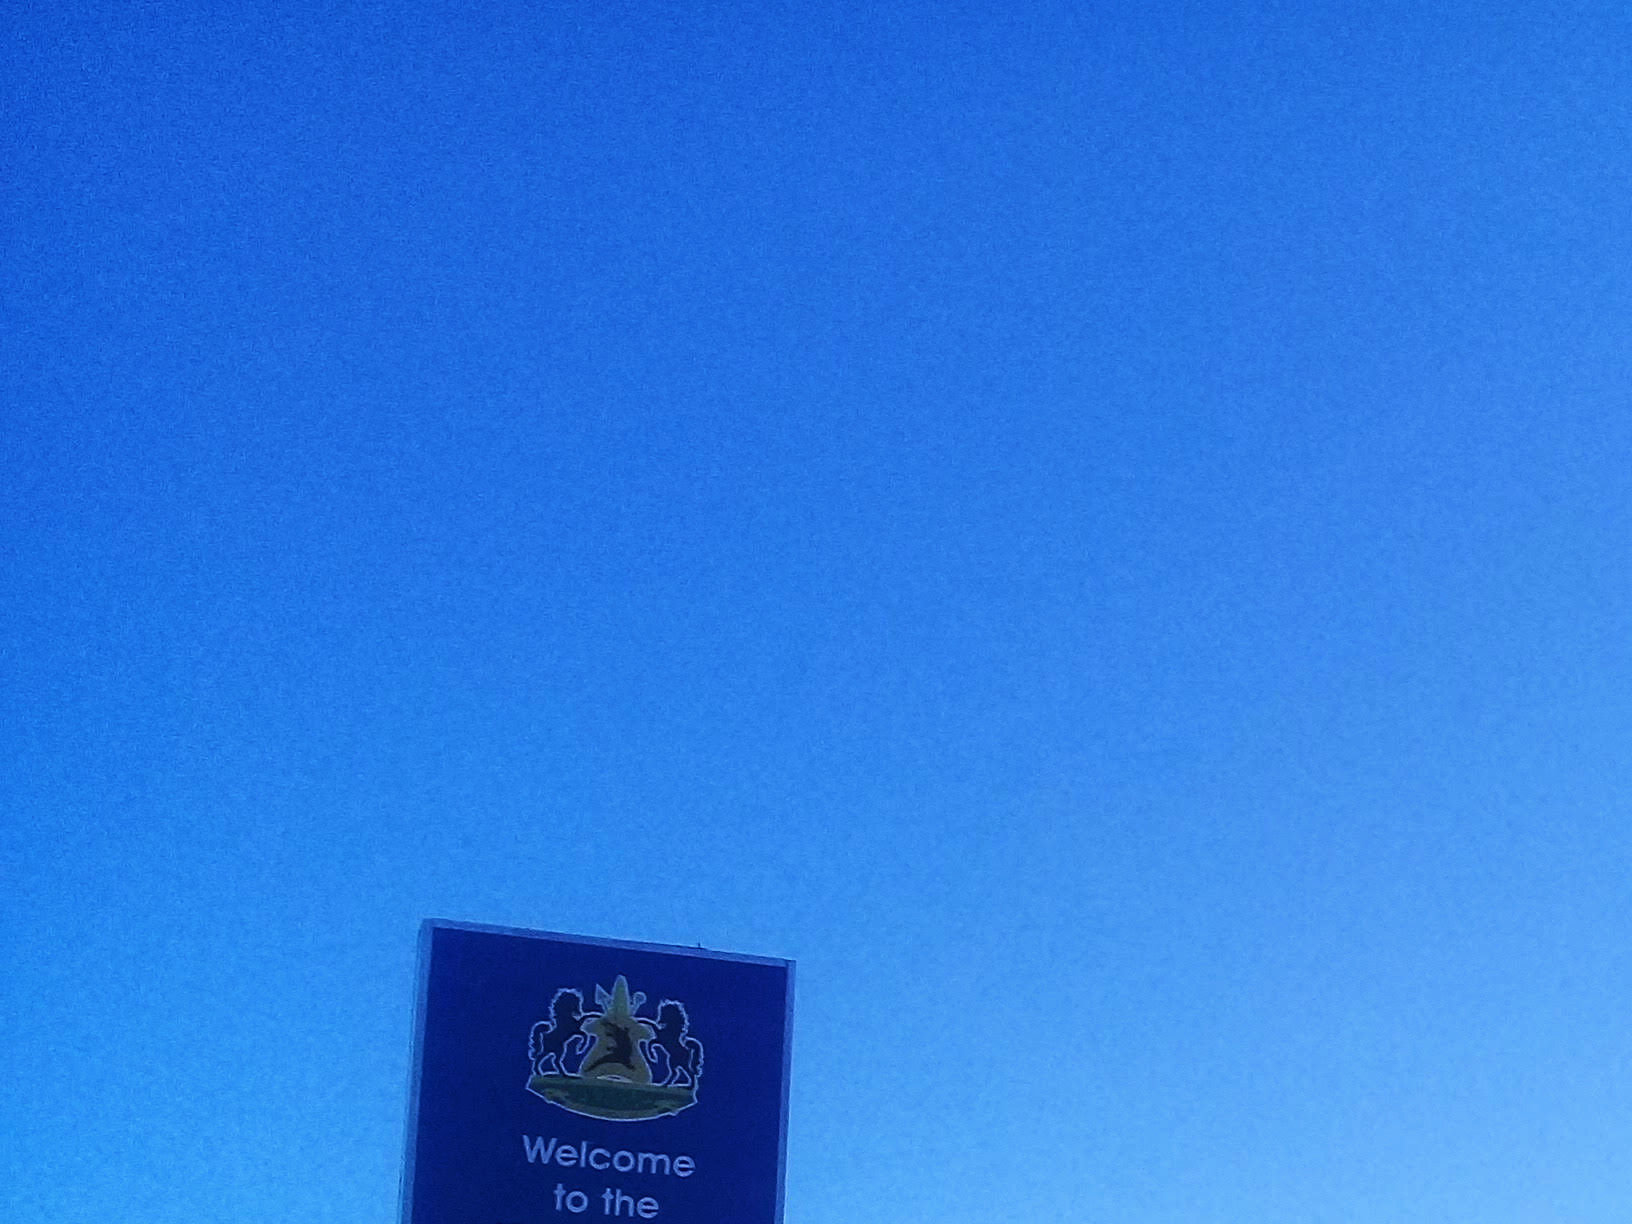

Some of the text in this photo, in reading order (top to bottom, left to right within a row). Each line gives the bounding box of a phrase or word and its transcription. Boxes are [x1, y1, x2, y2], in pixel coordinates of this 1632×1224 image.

[523, 1135, 696, 1178] Welcome
[554, 1183, 660, 1219] to the
